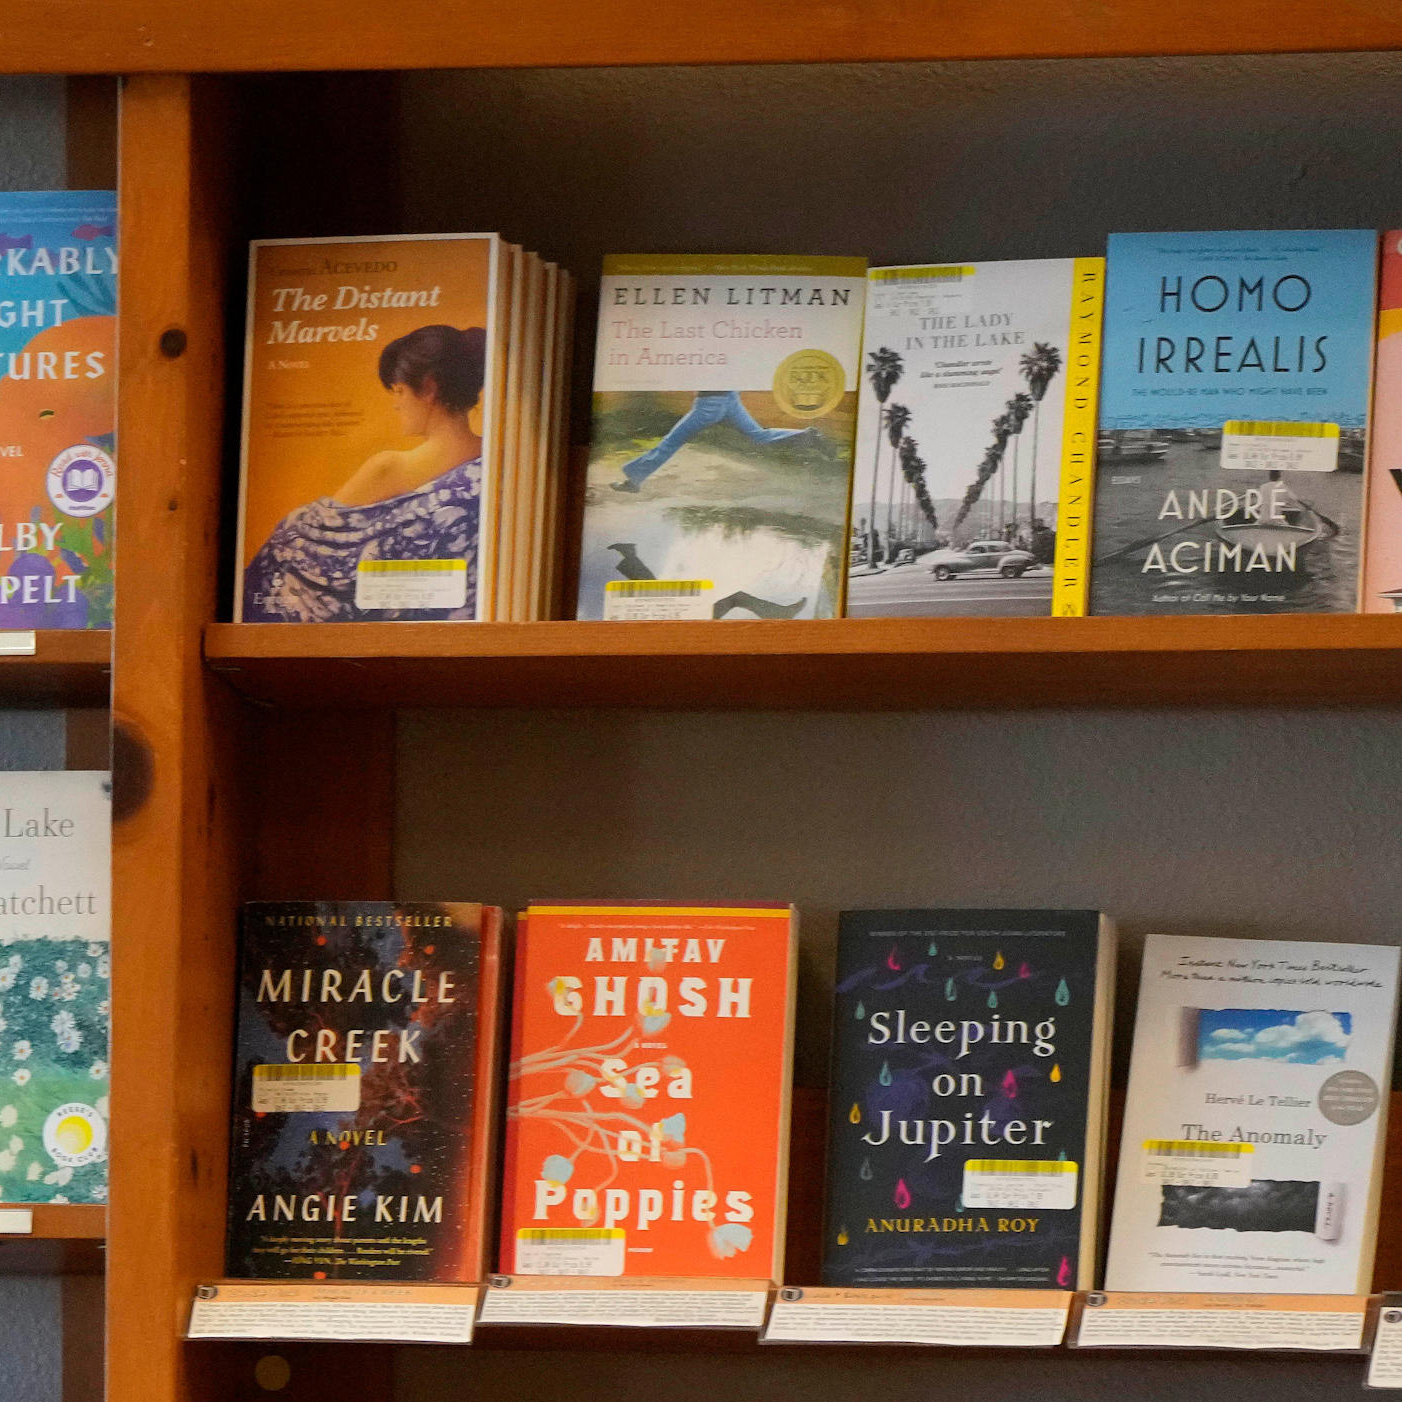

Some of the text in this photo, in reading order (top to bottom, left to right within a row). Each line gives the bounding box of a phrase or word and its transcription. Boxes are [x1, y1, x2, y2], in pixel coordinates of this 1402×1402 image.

[272, 285, 441, 313] The Distant
[613, 287, 852, 306] ELLEN LITMAN
[1161, 274, 1311, 313] HOMO
[266, 317, 378, 345] Marvels
[611, 320, 803, 340] The Last Chicken
[609, 347, 728, 366] in America
[1137, 335, 1329, 374] IRREALIS
[1063, 271, 1096, 590] RAYMOND CHANDLER
[1158, 480, 1287, 521] ANDRÉ
[1141, 543, 1297, 574] ACIMAN
[4, 808, 75, 838] Lake
[265, 915, 453, 928] NATIONAL BESTSELLER
[256, 969, 457, 1004] MIRACLE
[286, 1029, 421, 1063] CREEK
[867, 1010, 1057, 1061] Sleeping
[933, 1069, 984, 1097] on
[861, 1107, 1054, 1163] Jupiter
[1181, 1124, 1327, 1150] The Anomaly
[533, 1179, 755, 1230] Poppies
[865, 1217, 1040, 1234] ANURADHA ROY
